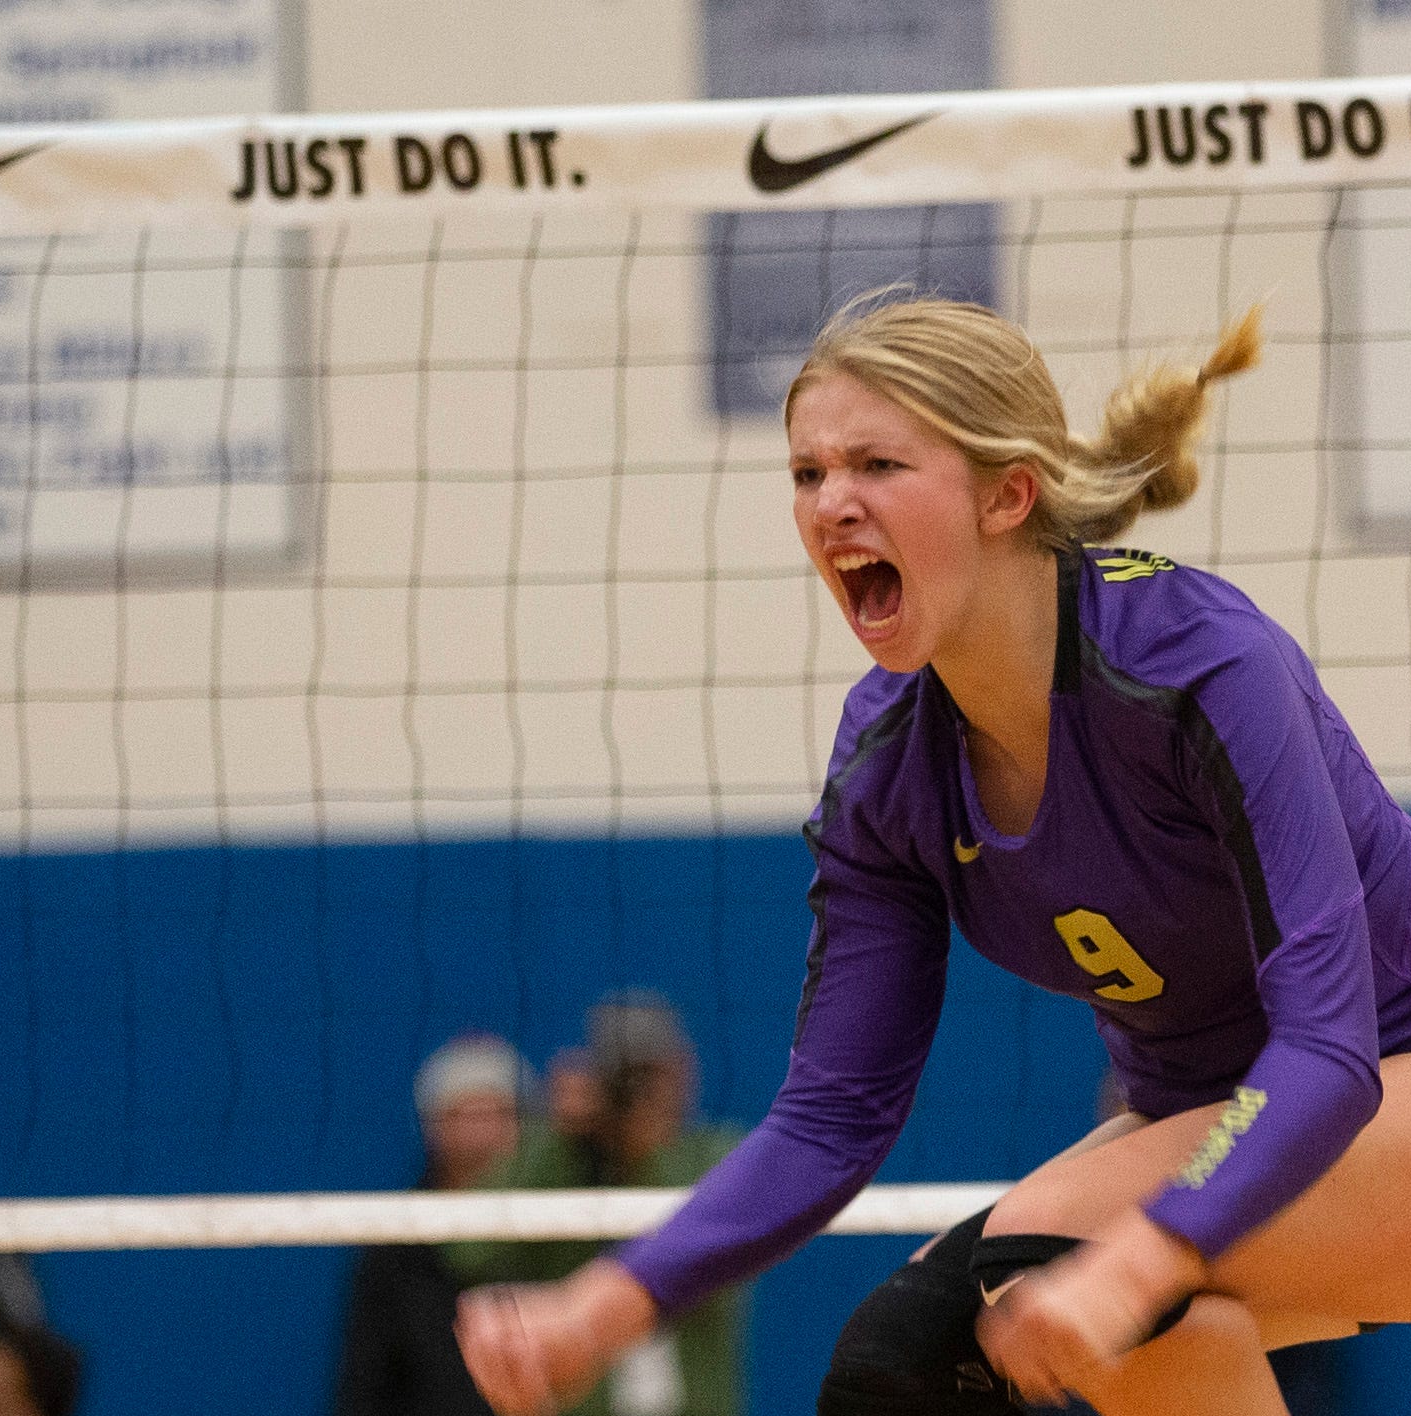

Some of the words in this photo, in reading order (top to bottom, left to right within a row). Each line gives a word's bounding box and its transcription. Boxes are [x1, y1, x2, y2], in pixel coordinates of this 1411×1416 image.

[231, 137, 366, 202] JUST
[394, 133, 483, 194] DO
[508, 130, 588, 189] IT.
[1127, 102, 1269, 168] JUST
[1294, 98, 1385, 161] DO
[1054, 908, 1165, 1003] 9
